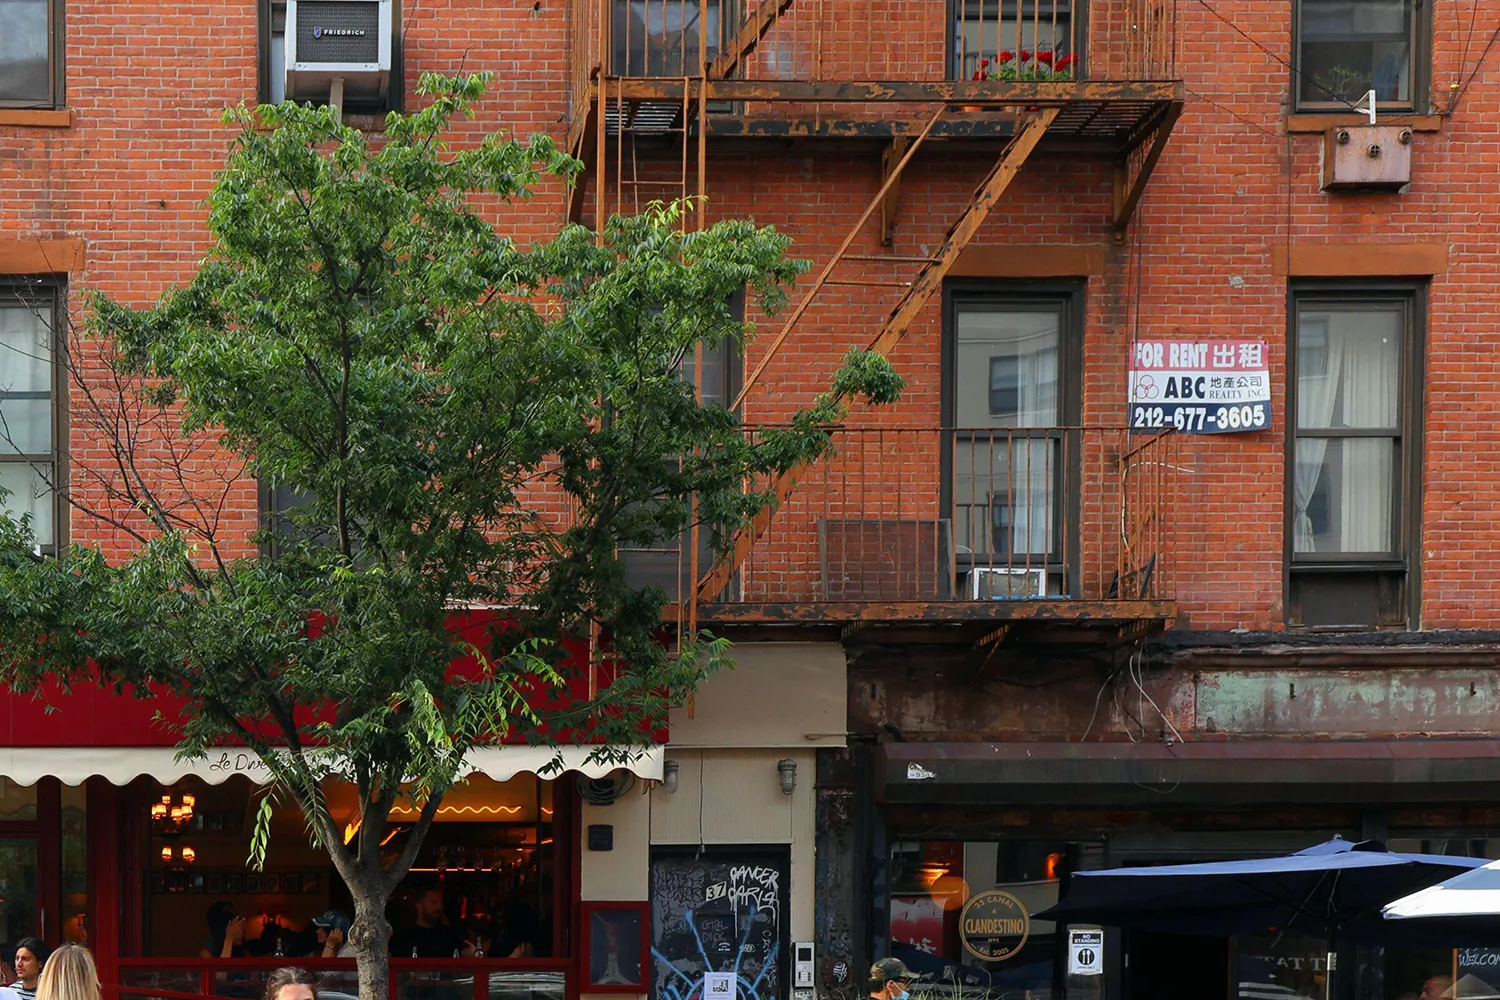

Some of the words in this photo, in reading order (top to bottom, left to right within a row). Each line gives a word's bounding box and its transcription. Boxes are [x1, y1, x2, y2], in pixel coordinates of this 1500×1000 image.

[323, 28, 365, 36] FRIEDRICH
[1136, 342, 1164, 368] FOR
[1169, 342, 1208, 368] RENT
[1212, 343, 1263, 368] 出租
[1163, 376, 1206, 399] ABC
[1210, 376, 1262, 388] 地產公司
[1209, 389, 1243, 399] REALTY
[1247, 388, 1266, 398] INC.
[1134, 404, 1266, 431] 212-677-3605
[209, 752, 231, 772] Le
[707, 882, 726, 900] 37
[974, 899, 985, 909] 35
[987, 895, 1014, 909] CANAL
[965, 918, 1024, 934] CLANDESTINO
